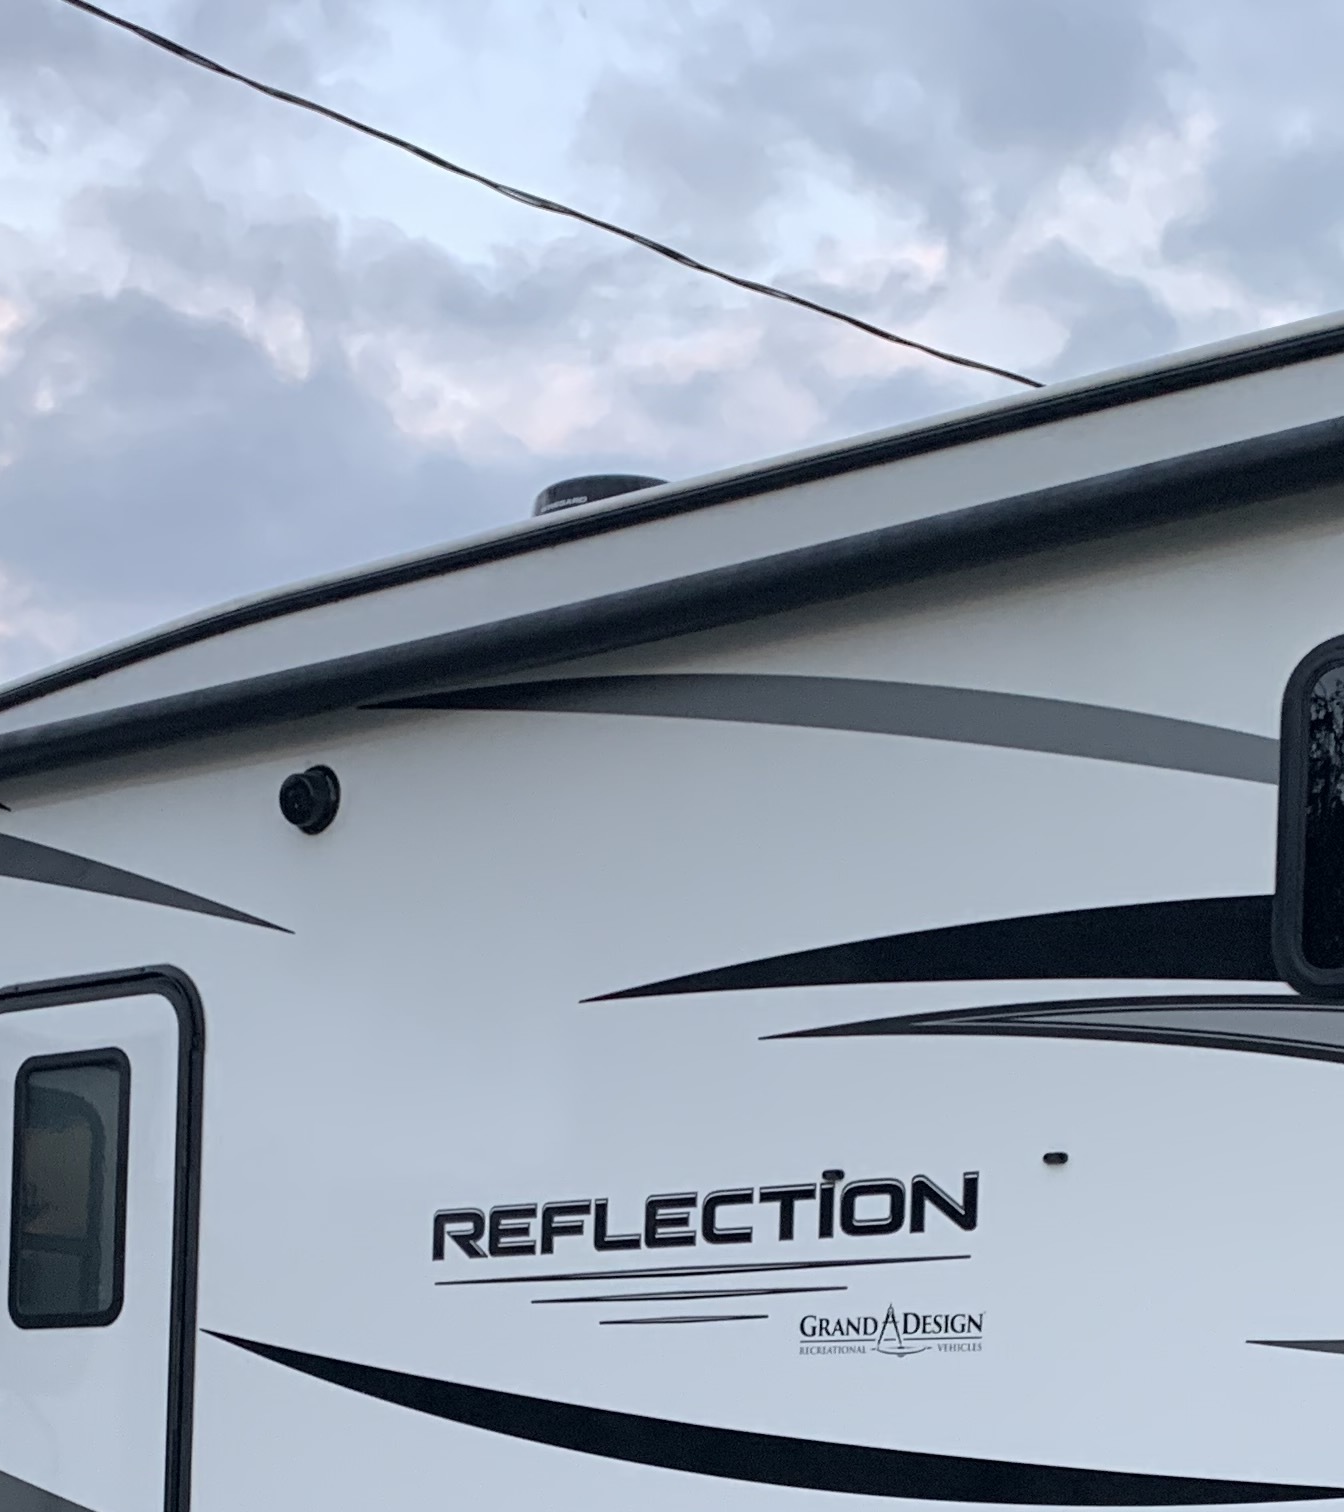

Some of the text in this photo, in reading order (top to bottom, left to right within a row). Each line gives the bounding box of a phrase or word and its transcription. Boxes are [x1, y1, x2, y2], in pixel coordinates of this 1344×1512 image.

[432, 1171, 979, 1261] REFLECTION
[799, 1312, 983, 1337] GRAND DESIGN
[799, 1343, 983, 1356] RECREATIONAL VEHICLES
